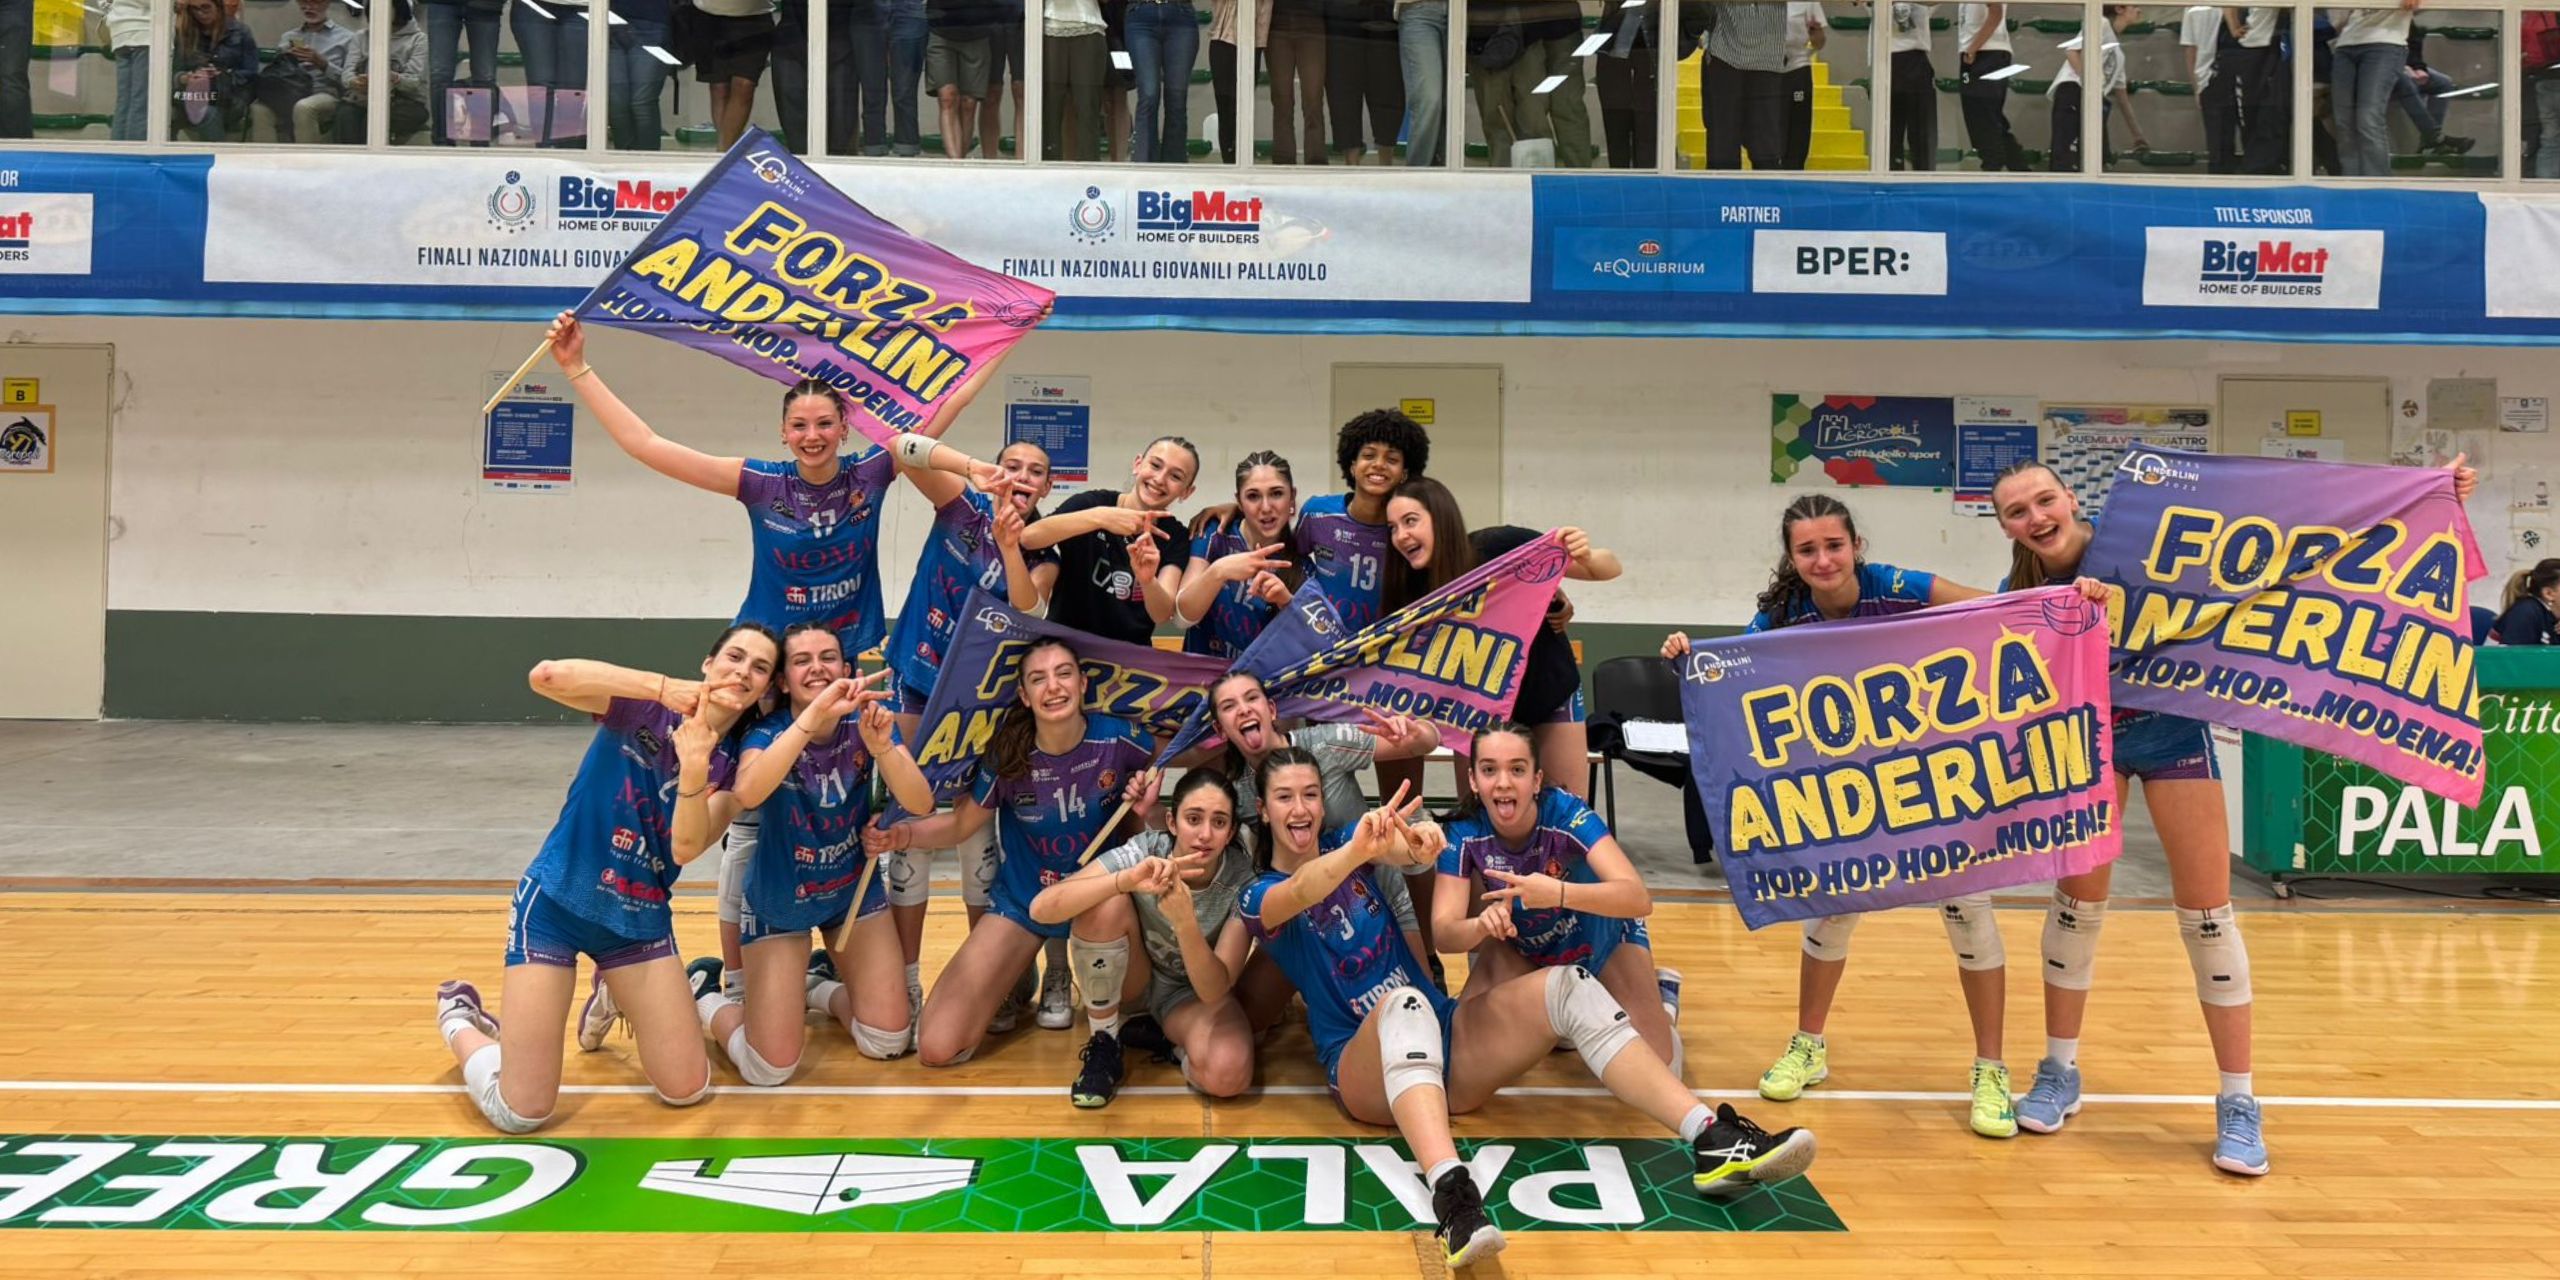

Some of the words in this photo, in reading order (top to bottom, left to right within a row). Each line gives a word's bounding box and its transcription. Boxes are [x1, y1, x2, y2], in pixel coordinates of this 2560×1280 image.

[558, 220, 598, 231] HOME
[601, 221, 619, 231] OF
[1137, 191, 1262, 231] BigMat
[1721, 206, 1780, 224] PARTNER
[2214, 207, 2250, 222] TITLE
[2253, 208, 2312, 224] SPONSOR
[1137, 232, 1175, 243] HOME
[1178, 232, 1196, 243] OF
[1199, 233, 1259, 244] BUILDERS
[418, 247, 472, 266] FINALI
[479, 248, 567, 268] NAZIONALI
[724, 201, 974, 332] FORZA
[1003, 258, 1055, 278] FINALI
[1061, 259, 1146, 279] NAZIONALI
[1152, 260, 1231, 280] GIOVANILI
[1237, 262, 1327, 281] PALLAVOLO
[1796, 246, 1909, 276] BPER:
[2201, 240, 2328, 282] BigMat
[2199, 284, 2236, 294] HOME
[2240, 285, 2258, 295] OF
[2261, 285, 2322, 296] BUILDERS
[16, 390, 25, 401] B
[1908, 450, 1941, 460] sport
[2145, 464, 2199, 481] ANDERLINI
[979, 559, 1002, 590] 8
[1350, 553, 1378, 591] 13
[1741, 629, 2058, 768] FORZA
[1053, 783, 1086, 823] 14
[2338, 785, 2542, 855] PALA
[1749, 868, 1816, 901] HOP
[1820, 855, 1896, 895] HOP
[1330, 904, 1355, 940] 3
[1075, 1145, 1645, 1225] PALA
